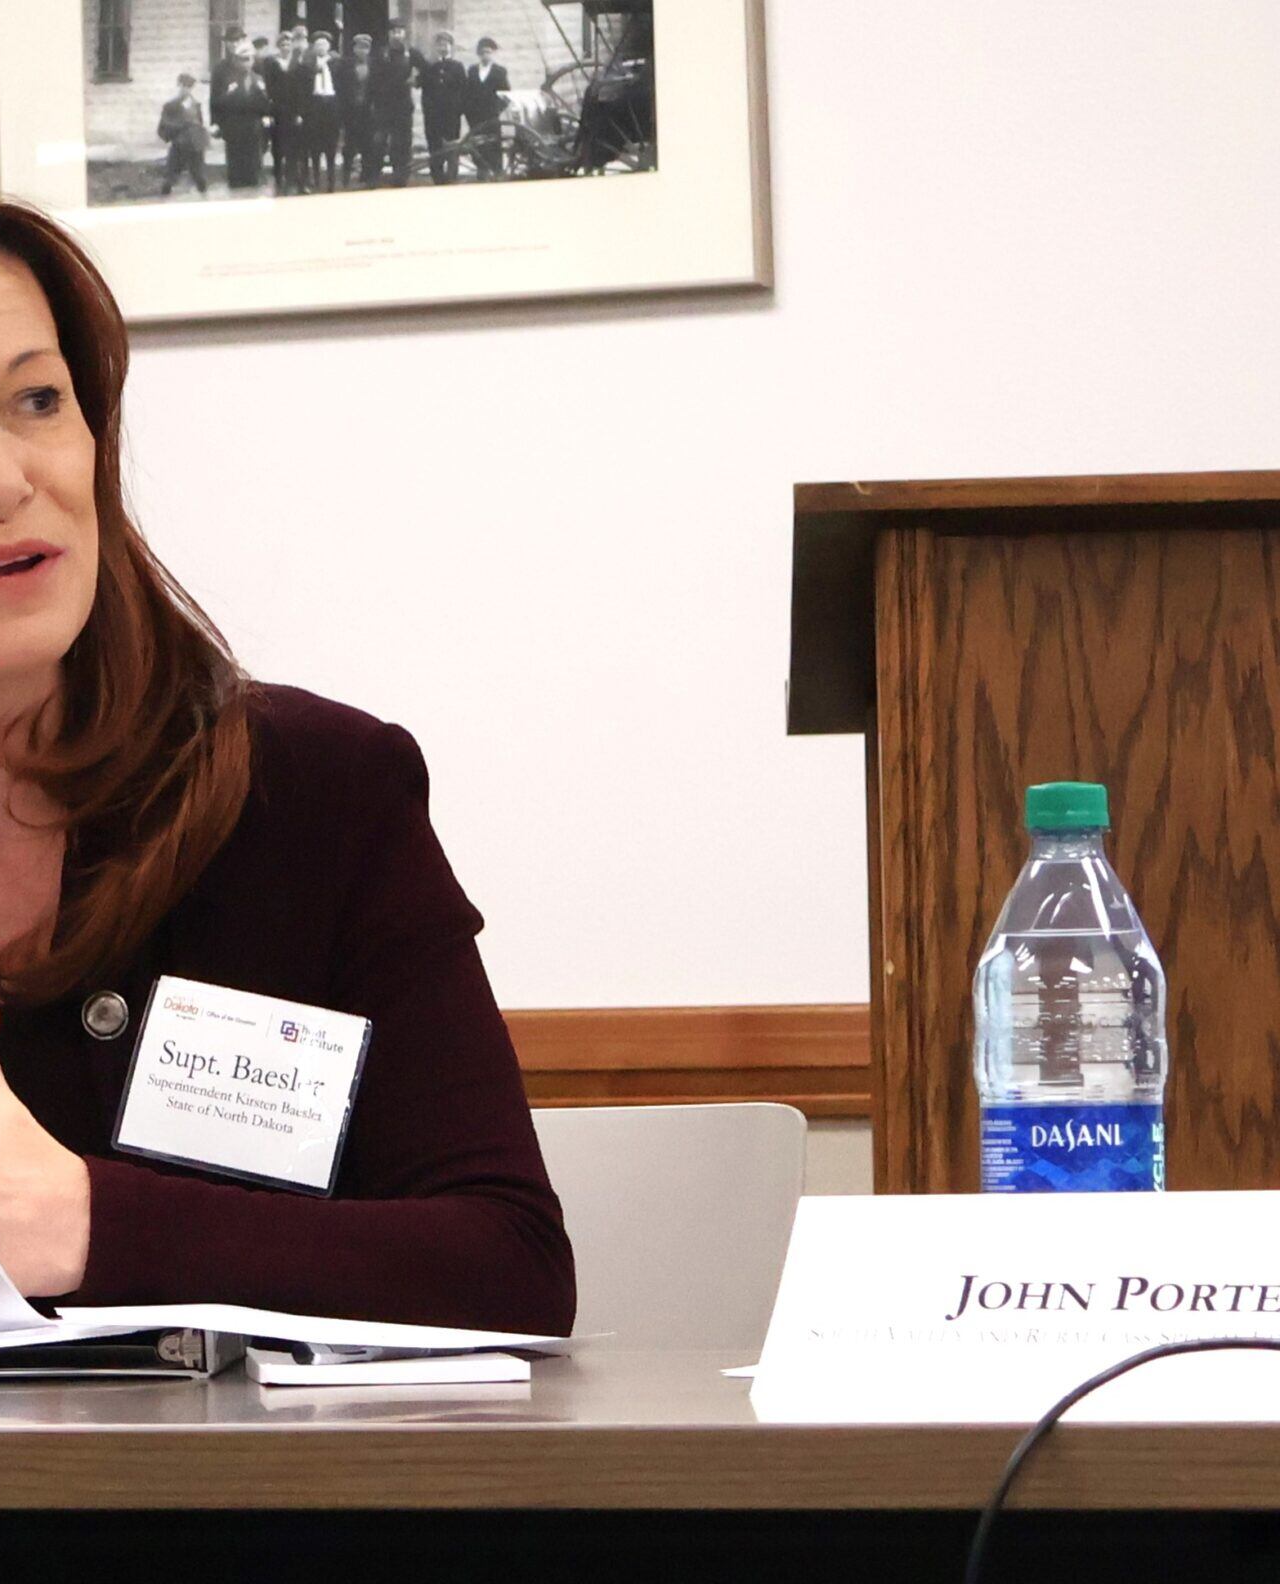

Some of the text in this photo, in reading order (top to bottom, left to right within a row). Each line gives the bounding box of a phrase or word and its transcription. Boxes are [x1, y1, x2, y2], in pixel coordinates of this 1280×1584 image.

[163, 996, 199, 1016] Dakota
[159, 1039, 325, 1097] Supt. Baeslr
[147, 1073, 232, 1102] Superintendent
[235, 1091, 277, 1112] Kirsten
[166, 1096, 294, 1134] State of North Dakota
[1031, 1118, 1124, 1152] DASANI
[945, 1275, 1280, 1321] JOHN PORTE
